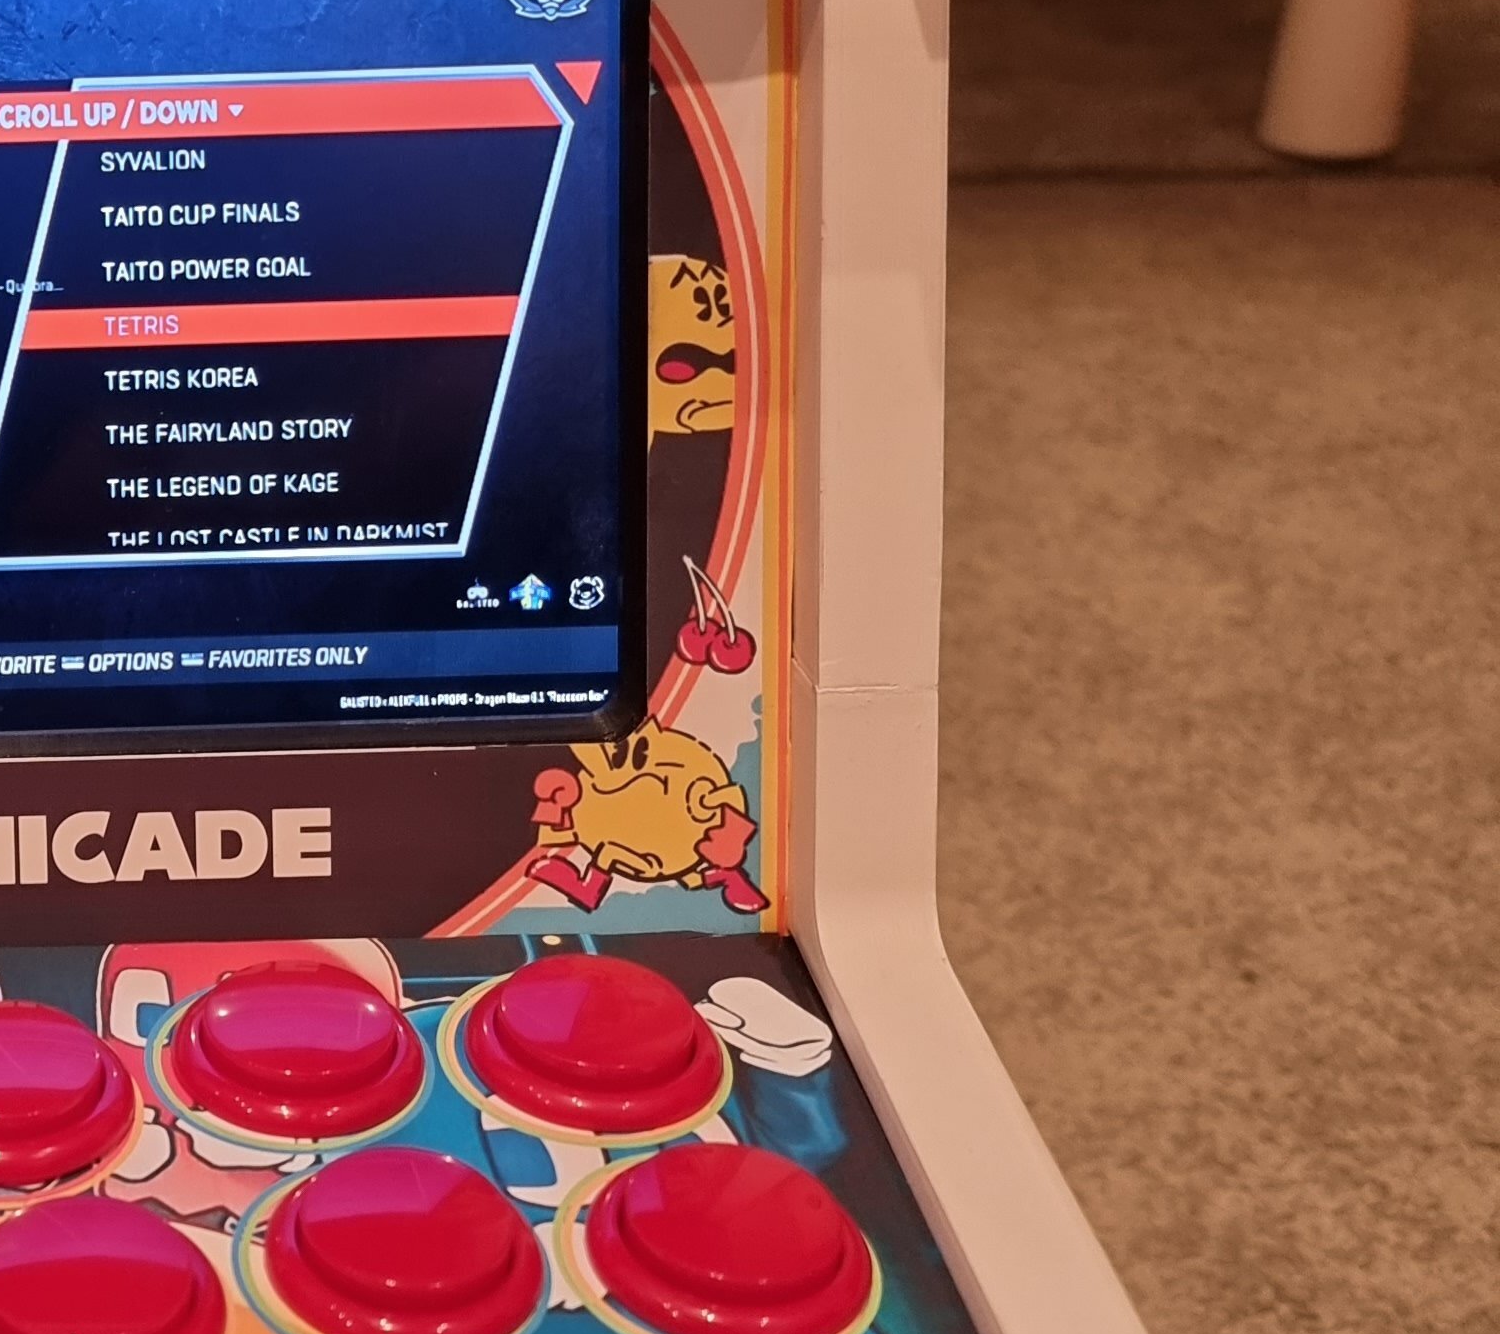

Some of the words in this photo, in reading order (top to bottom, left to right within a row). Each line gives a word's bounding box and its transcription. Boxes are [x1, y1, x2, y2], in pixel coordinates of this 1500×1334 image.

[83, 101, 116, 127] UP
[140, 100, 217, 125] DOWN
[101, 150, 205, 172] SYVALION
[101, 206, 162, 227] TAITO
[170, 205, 215, 225] CUP
[222, 202, 300, 224] FINALS
[102, 261, 164, 282] TAITO
[171, 259, 248, 280] POWER
[256, 257, 311, 278] GOAL
[104, 315, 179, 336] TETRIS
[105, 369, 180, 391] TETRIS
[188, 367, 258, 388] KOREA
[106, 424, 148, 445] THE
[156, 420, 273, 443] FAIRYLAND
[281, 418, 352, 439] STORY
[107, 478, 149, 499] THE
[157, 475, 240, 497] LEGEND
[250, 474, 277, 495] OF
[285, 472, 339, 493] KAGE
[108, 531, 149, 547] THE
[308, 525, 328, 542] IN
[88, 652, 174, 672] OPTIONS
[208, 648, 311, 668] FAVORITES
[315, 646, 369, 666] ONLY
